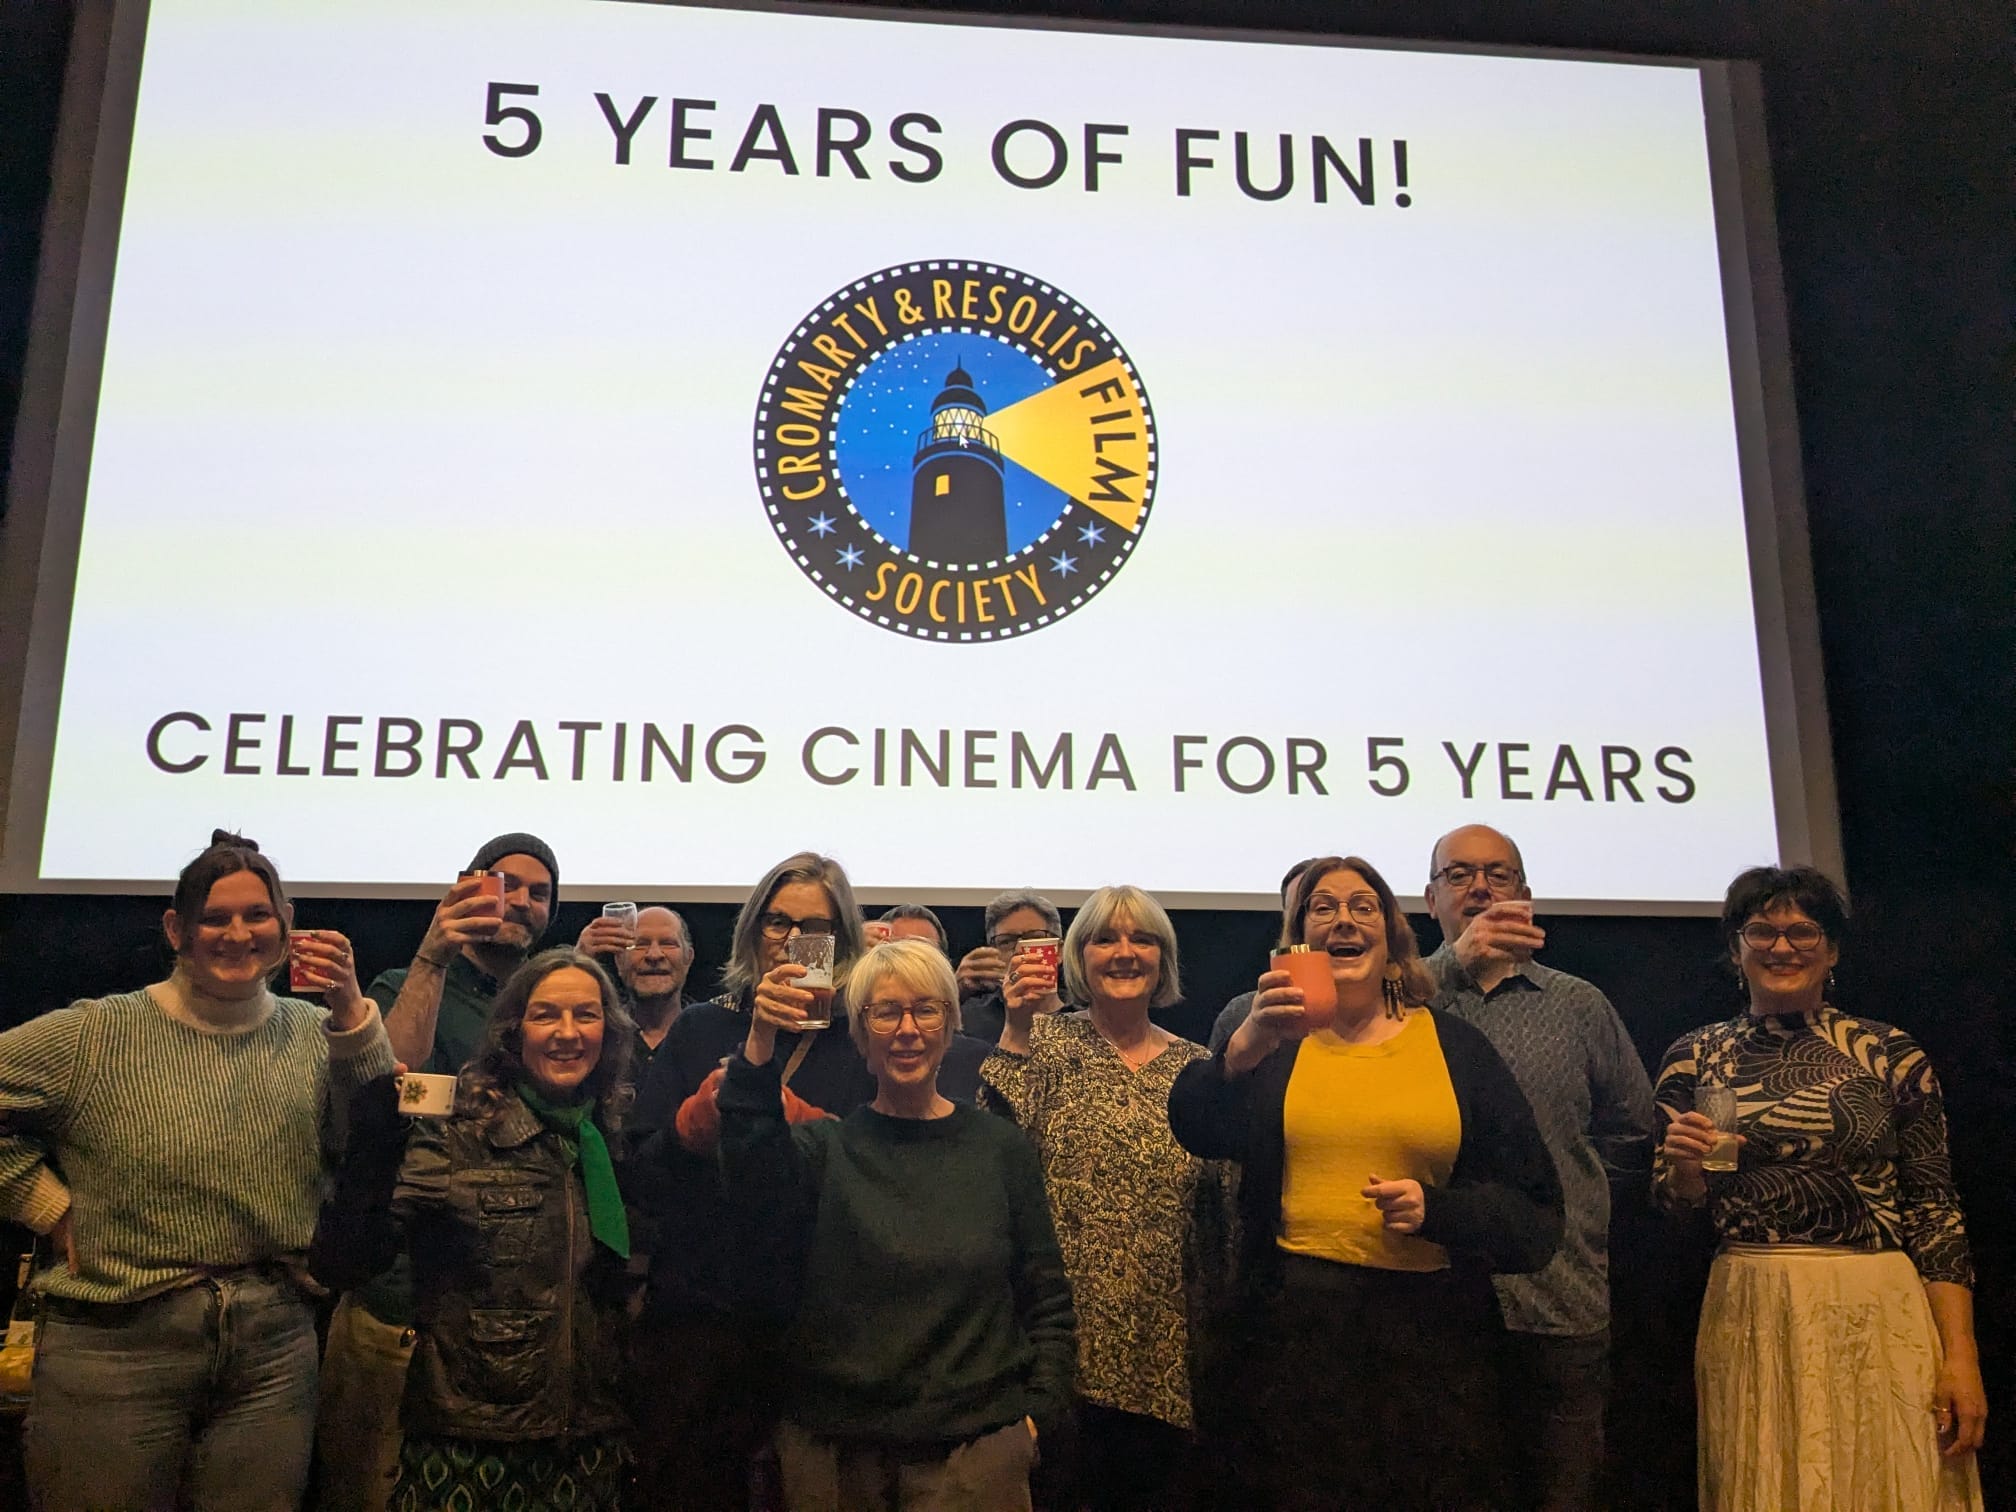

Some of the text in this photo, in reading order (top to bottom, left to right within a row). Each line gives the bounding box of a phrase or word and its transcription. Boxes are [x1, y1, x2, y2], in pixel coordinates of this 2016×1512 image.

[482, 81, 1412, 209] 5 YEARS OF FUN!
[775, 279, 1140, 504] CROMARTY & RESOLIS FILM
[865, 561, 1048, 624] SOCIETY
[146, 711, 1696, 804] CELEBRATING CINEMA FOR 5 YEARS
